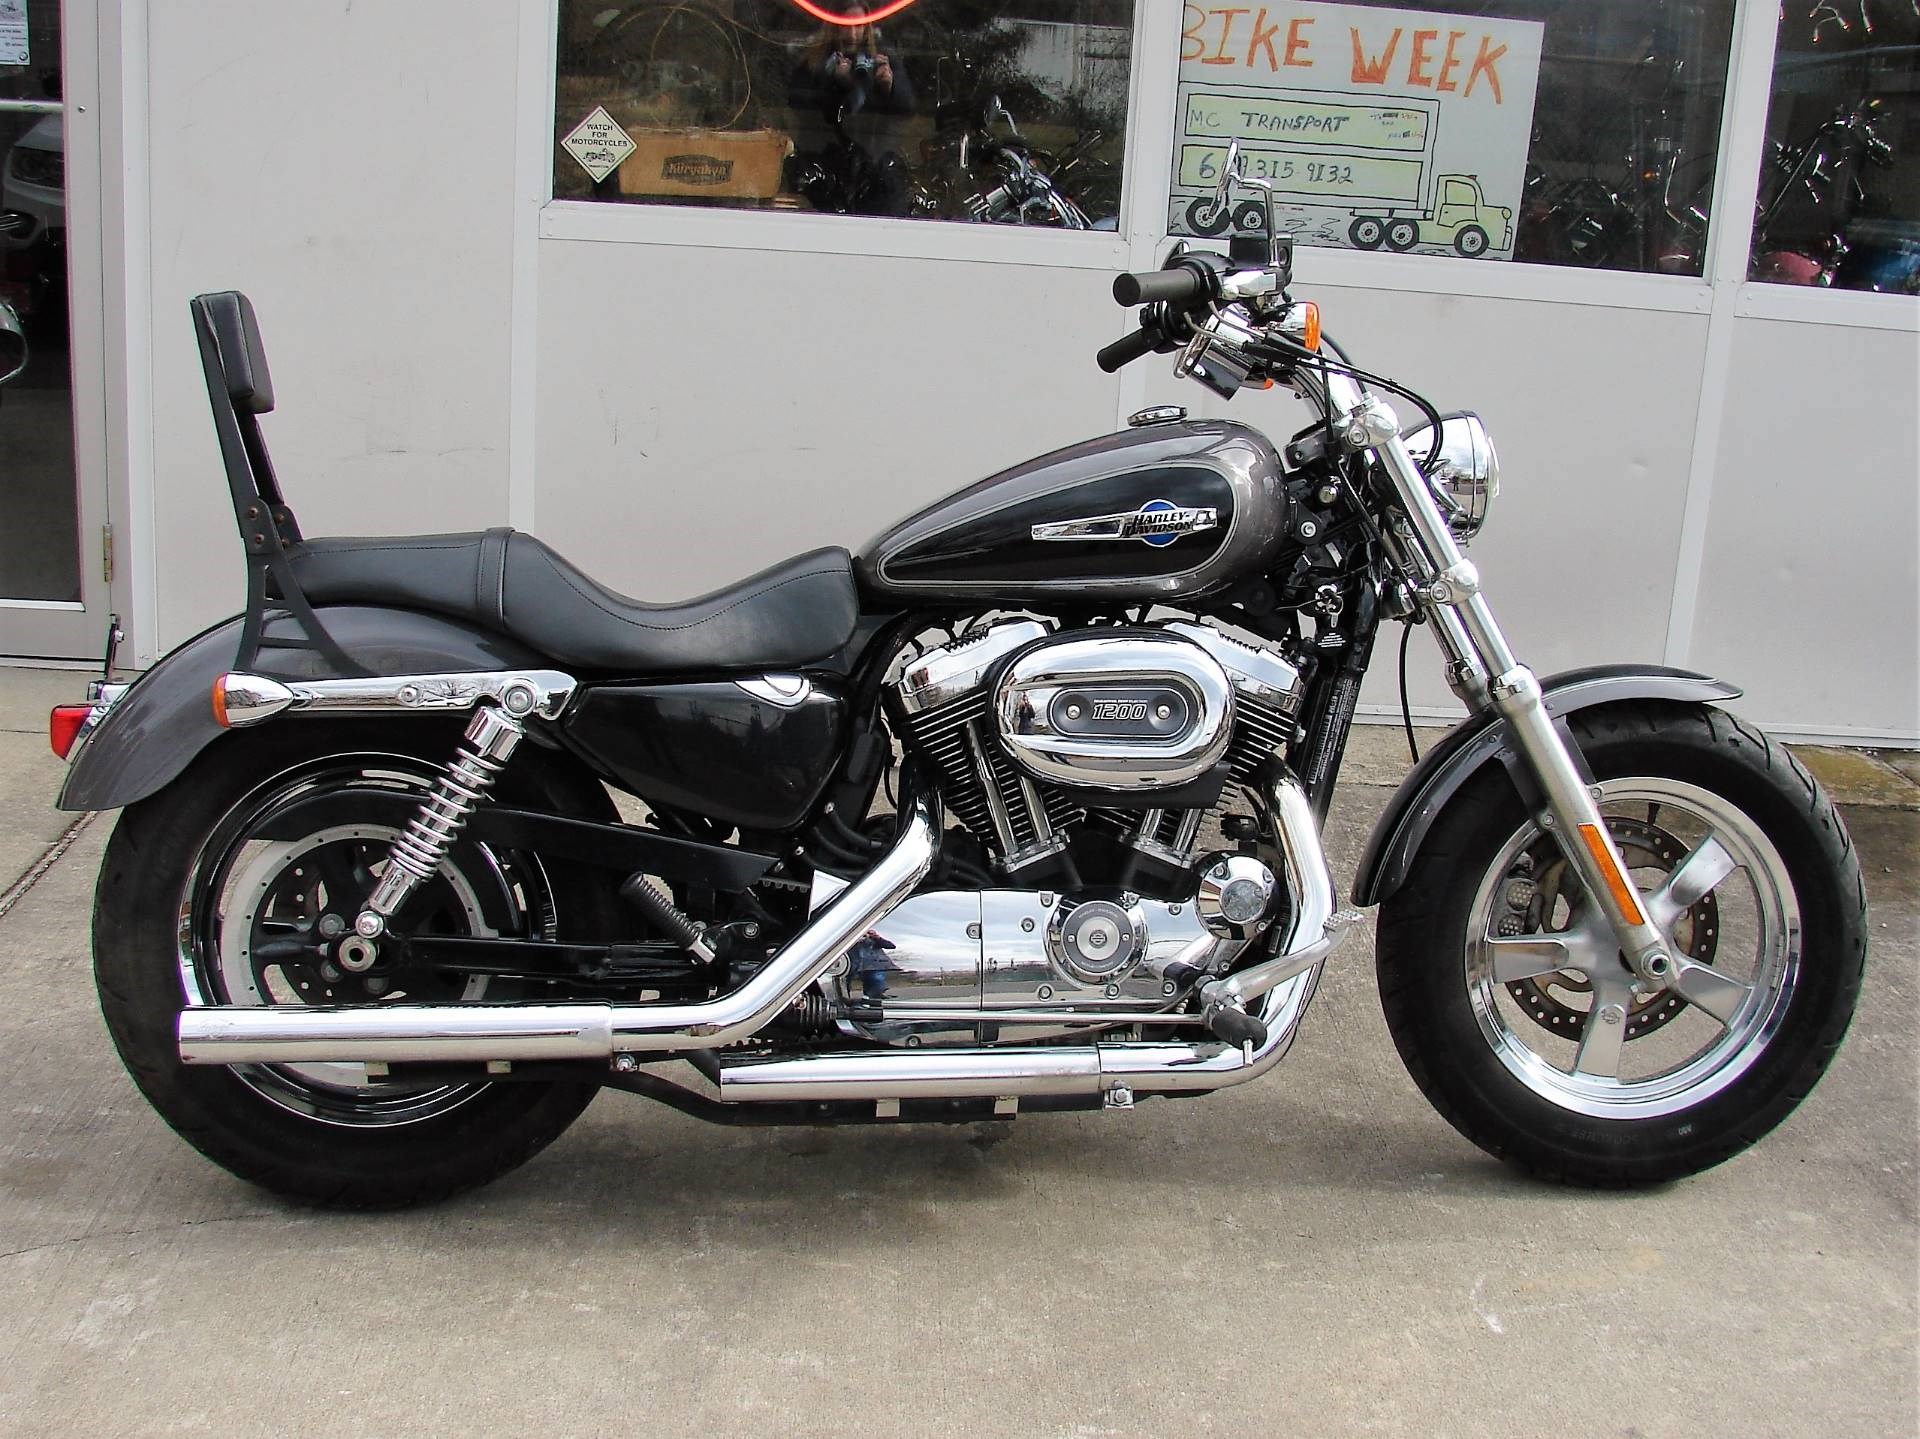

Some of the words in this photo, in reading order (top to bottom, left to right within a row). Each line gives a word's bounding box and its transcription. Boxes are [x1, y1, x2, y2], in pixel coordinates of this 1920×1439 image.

[1182, 4, 1315, 72] BIKE
[1350, 27, 1507, 104] WEEK
[1189, 109, 1220, 128] MC
[1241, 112, 1350, 132] TRANSPORT
[571, 138, 628, 147] MOTORCYCLES
[1121, 518, 1196, 538] DAVIDSON
[1092, 703, 1148, 720] 1200
